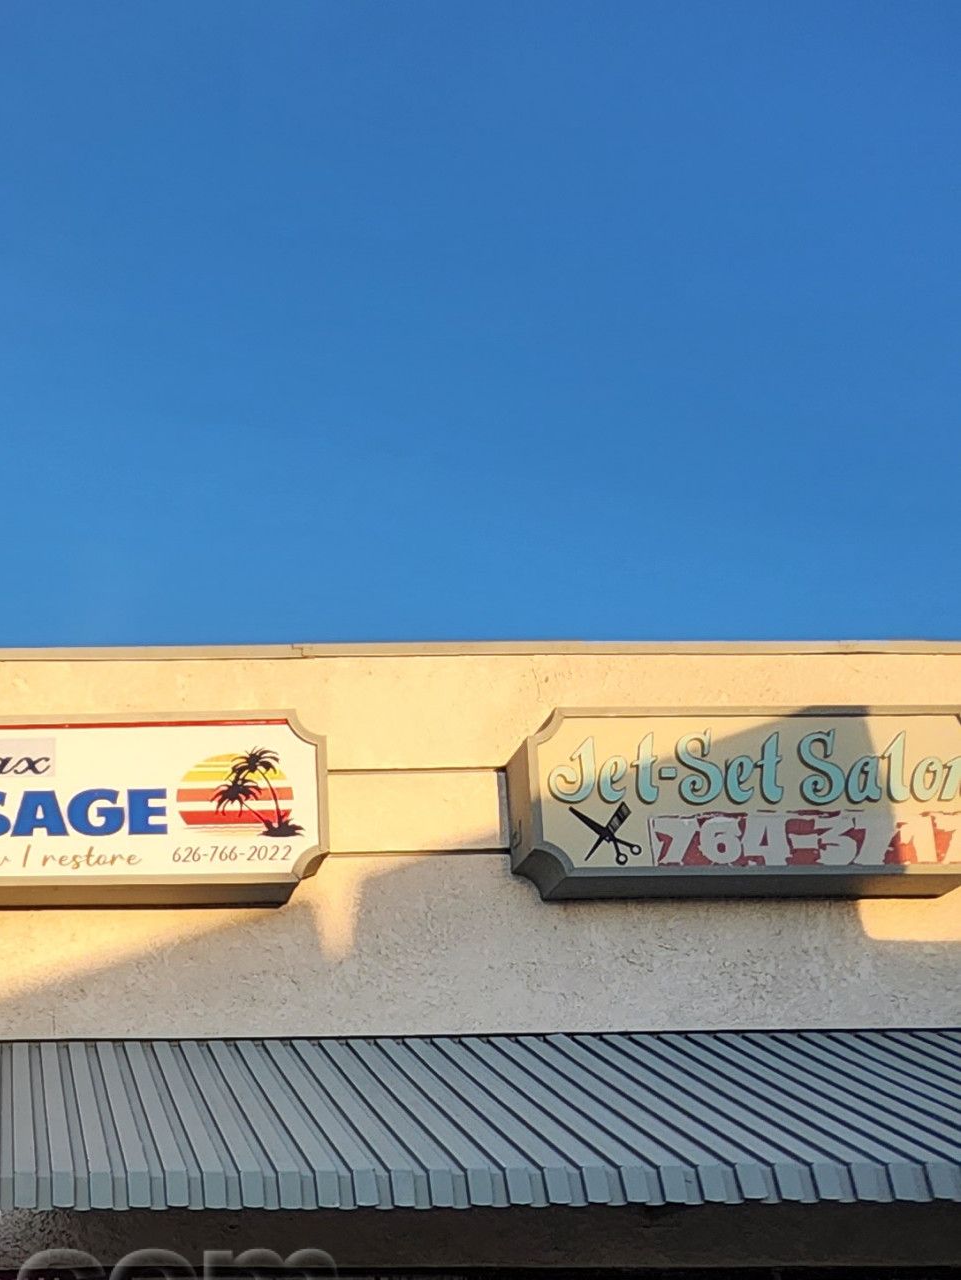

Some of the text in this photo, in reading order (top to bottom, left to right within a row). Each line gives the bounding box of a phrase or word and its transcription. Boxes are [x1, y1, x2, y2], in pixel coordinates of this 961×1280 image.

[548, 729, 785, 804] Jet-Set
[42, 846, 142, 868] restore
[172, 844, 293, 863] 626-766-2022
